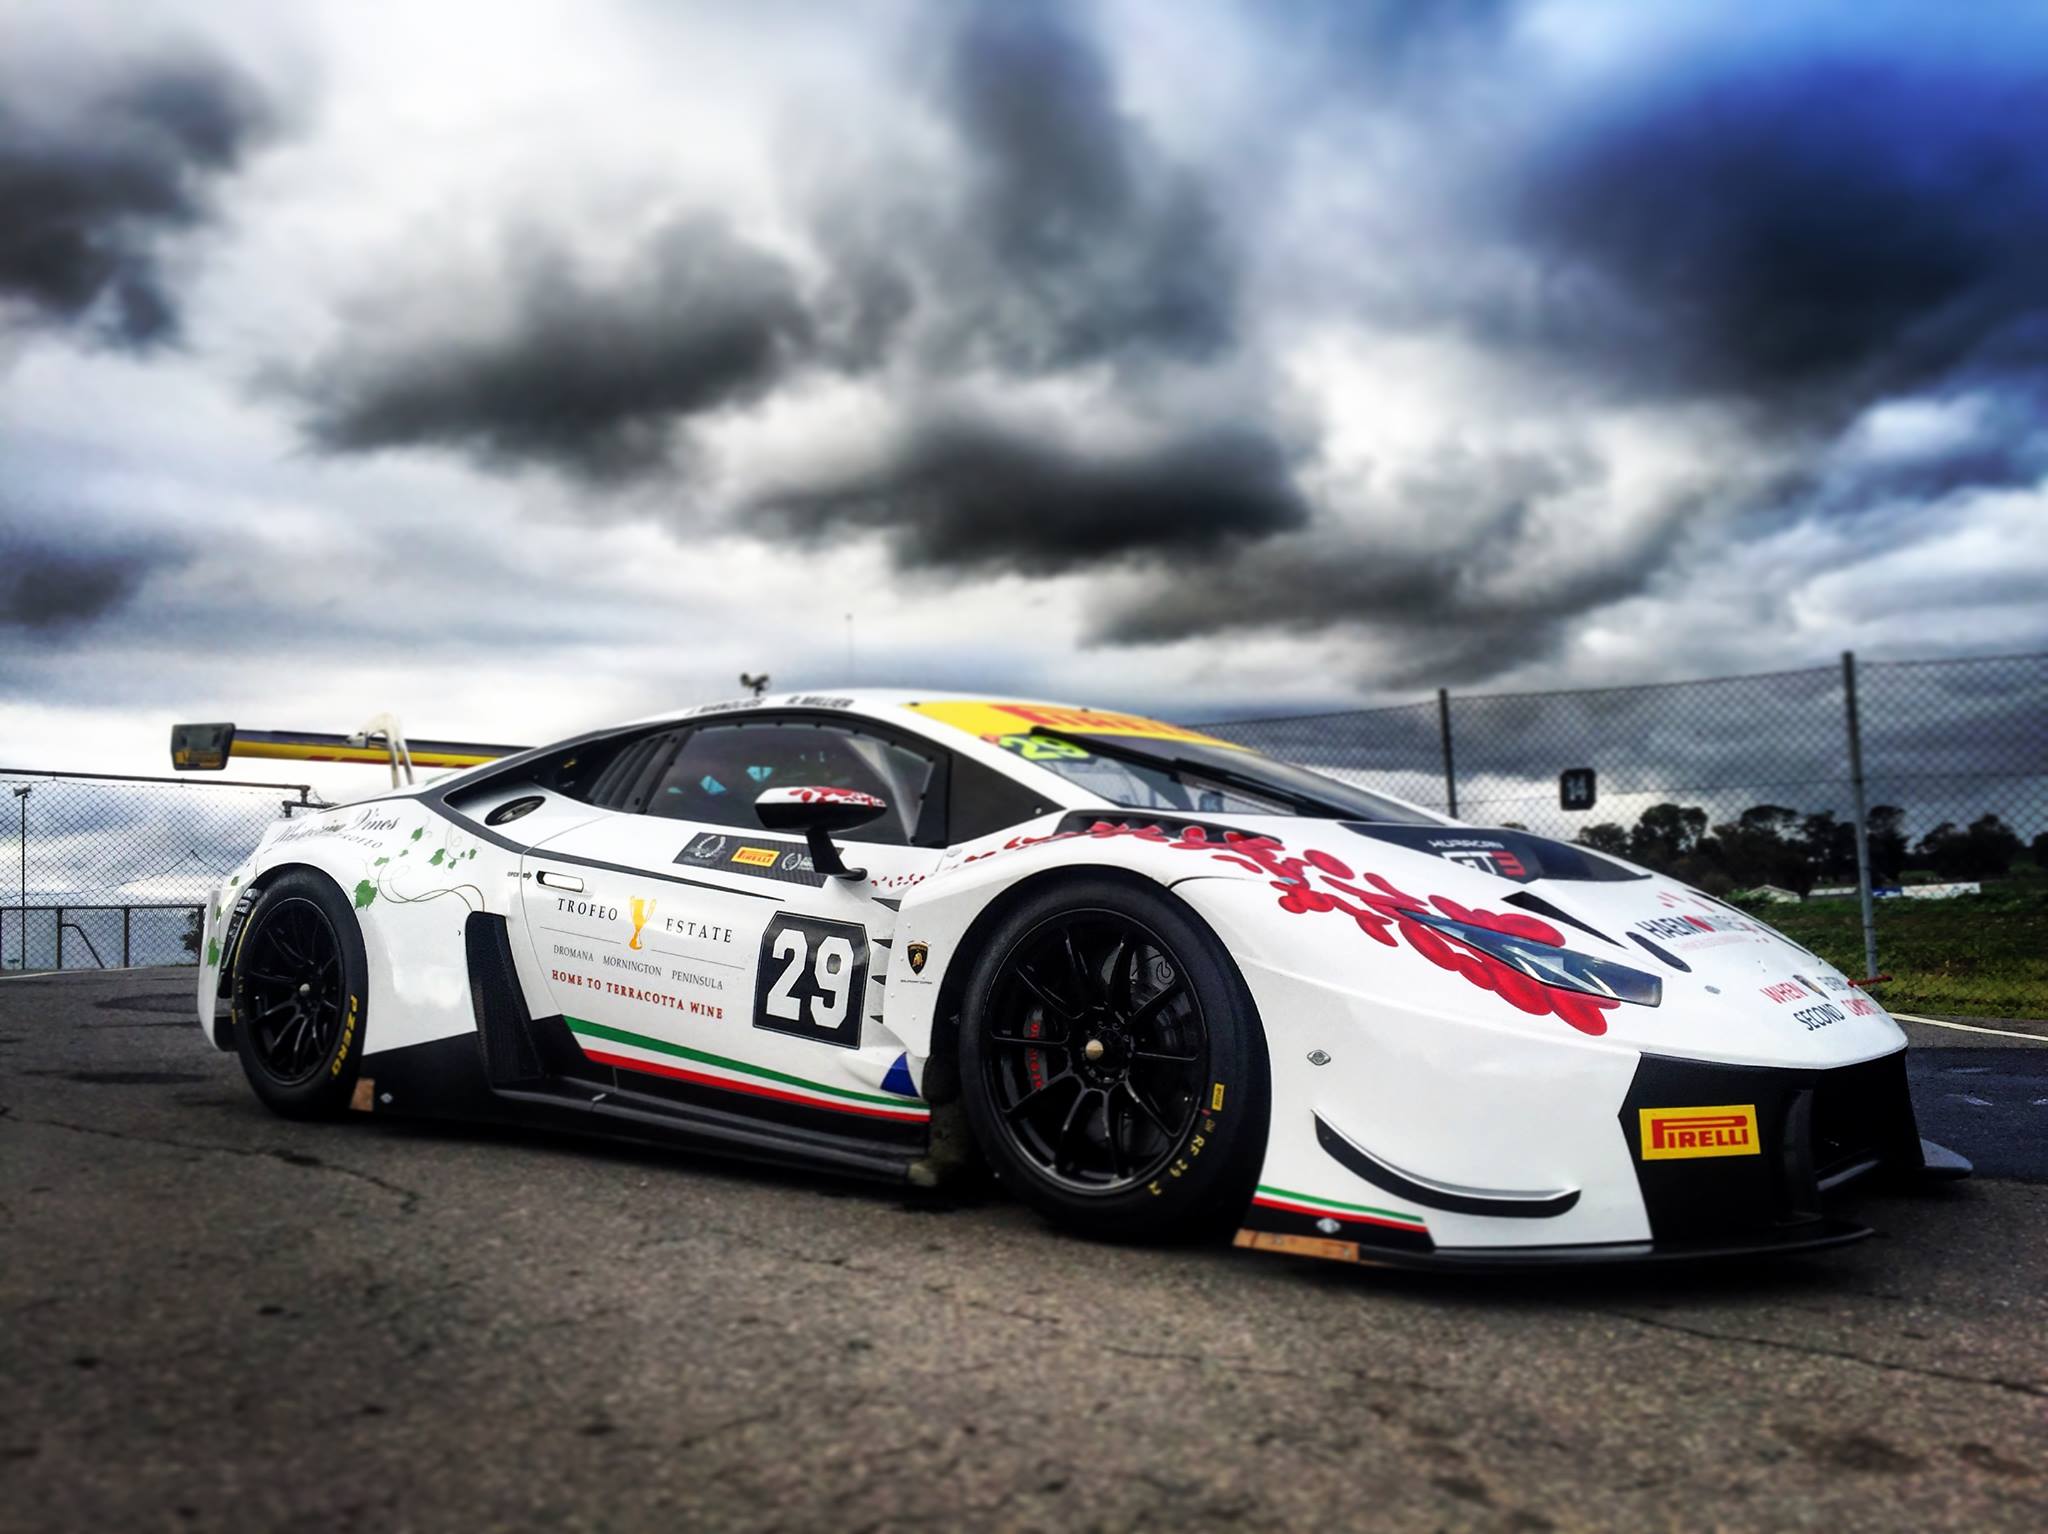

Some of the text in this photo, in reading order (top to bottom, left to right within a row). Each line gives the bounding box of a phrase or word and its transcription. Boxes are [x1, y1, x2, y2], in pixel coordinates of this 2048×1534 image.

[558, 898, 733, 943] TROFEO ESTATE
[553, 944, 723, 990] DROMANA MORNINGTON PENINSULA
[766, 928, 854, 1029] 29
[552, 969, 723, 1019] HOME TO TERRACOTTA WINE
[1760, 982, 1808, 1004] WHEN
[1793, 1003, 1845, 1031] SECOND
[1651, 1115, 1749, 1149] PIRELLI
